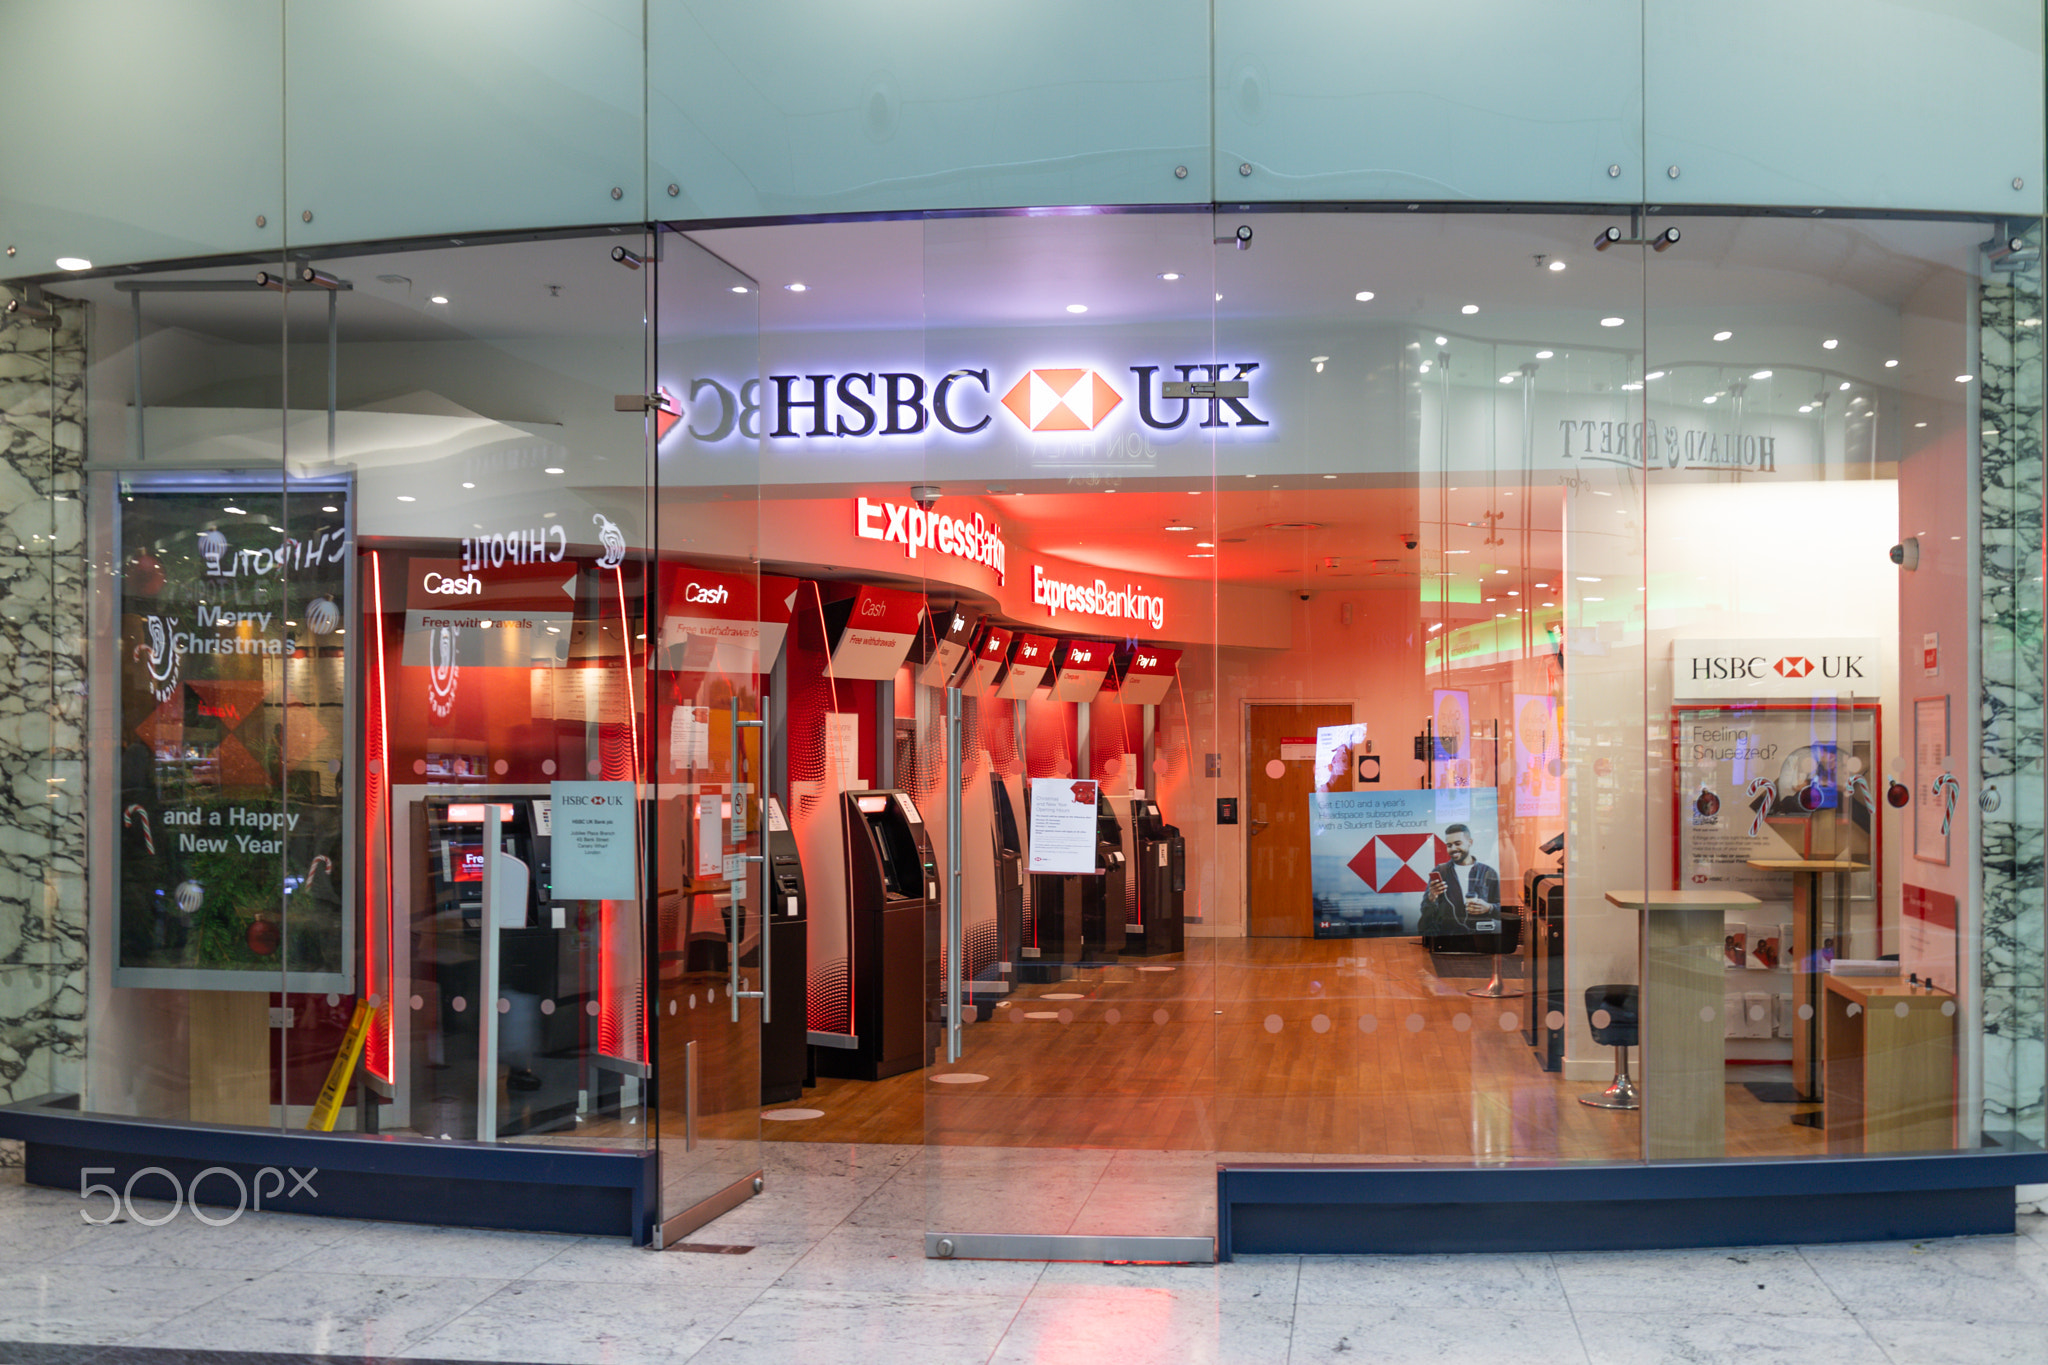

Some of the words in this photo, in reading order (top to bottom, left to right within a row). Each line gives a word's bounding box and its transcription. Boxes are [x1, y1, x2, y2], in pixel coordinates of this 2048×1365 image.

[769, 367, 992, 439] HSBC
[1129, 362, 1270, 430] UK
[423, 572, 482, 595] Cash
[685, 582, 729, 605] Cash
[1031, 564, 1165, 630] ExpressBanking
[861, 598, 887, 618] Cash
[197, 605, 273, 632] Merry
[422, 616, 450, 628] Free
[453, 617, 533, 629] withrawals
[676, 623, 697, 635] Free
[699, 625, 760, 639] withdrawals
[172, 632, 296, 655] Christmas
[849, 634, 862, 646] Free
[862, 635, 897, 649] withdrawals
[1070, 648, 1083, 664] Pay
[1082, 649, 1092, 662] in
[1136, 654, 1149, 669] Pay
[1148, 655, 1157, 668] in
[1691, 656, 1767, 681] HSBC
[1821, 655, 1866, 680] UK
[1693, 725, 1748, 746] Feeling
[562, 795, 589, 805] HSBC
[606, 795, 623, 805] UK
[1335, 799, 1354, 808] £100
[1357, 799, 1372, 807] and
[1383, 798, 1405, 808] year's
[163, 806, 202, 826] and
[208, 810, 222, 827] a
[229, 806, 300, 832] Happy
[1366, 808, 1413, 819] subscription
[1336, 822, 1342, 830] a
[1344, 819, 1373, 830] Student
[1375, 819, 1395, 829] Bank
[1396, 819, 1428, 828] Account
[179, 833, 229, 853] New
[234, 834, 284, 854] Year
